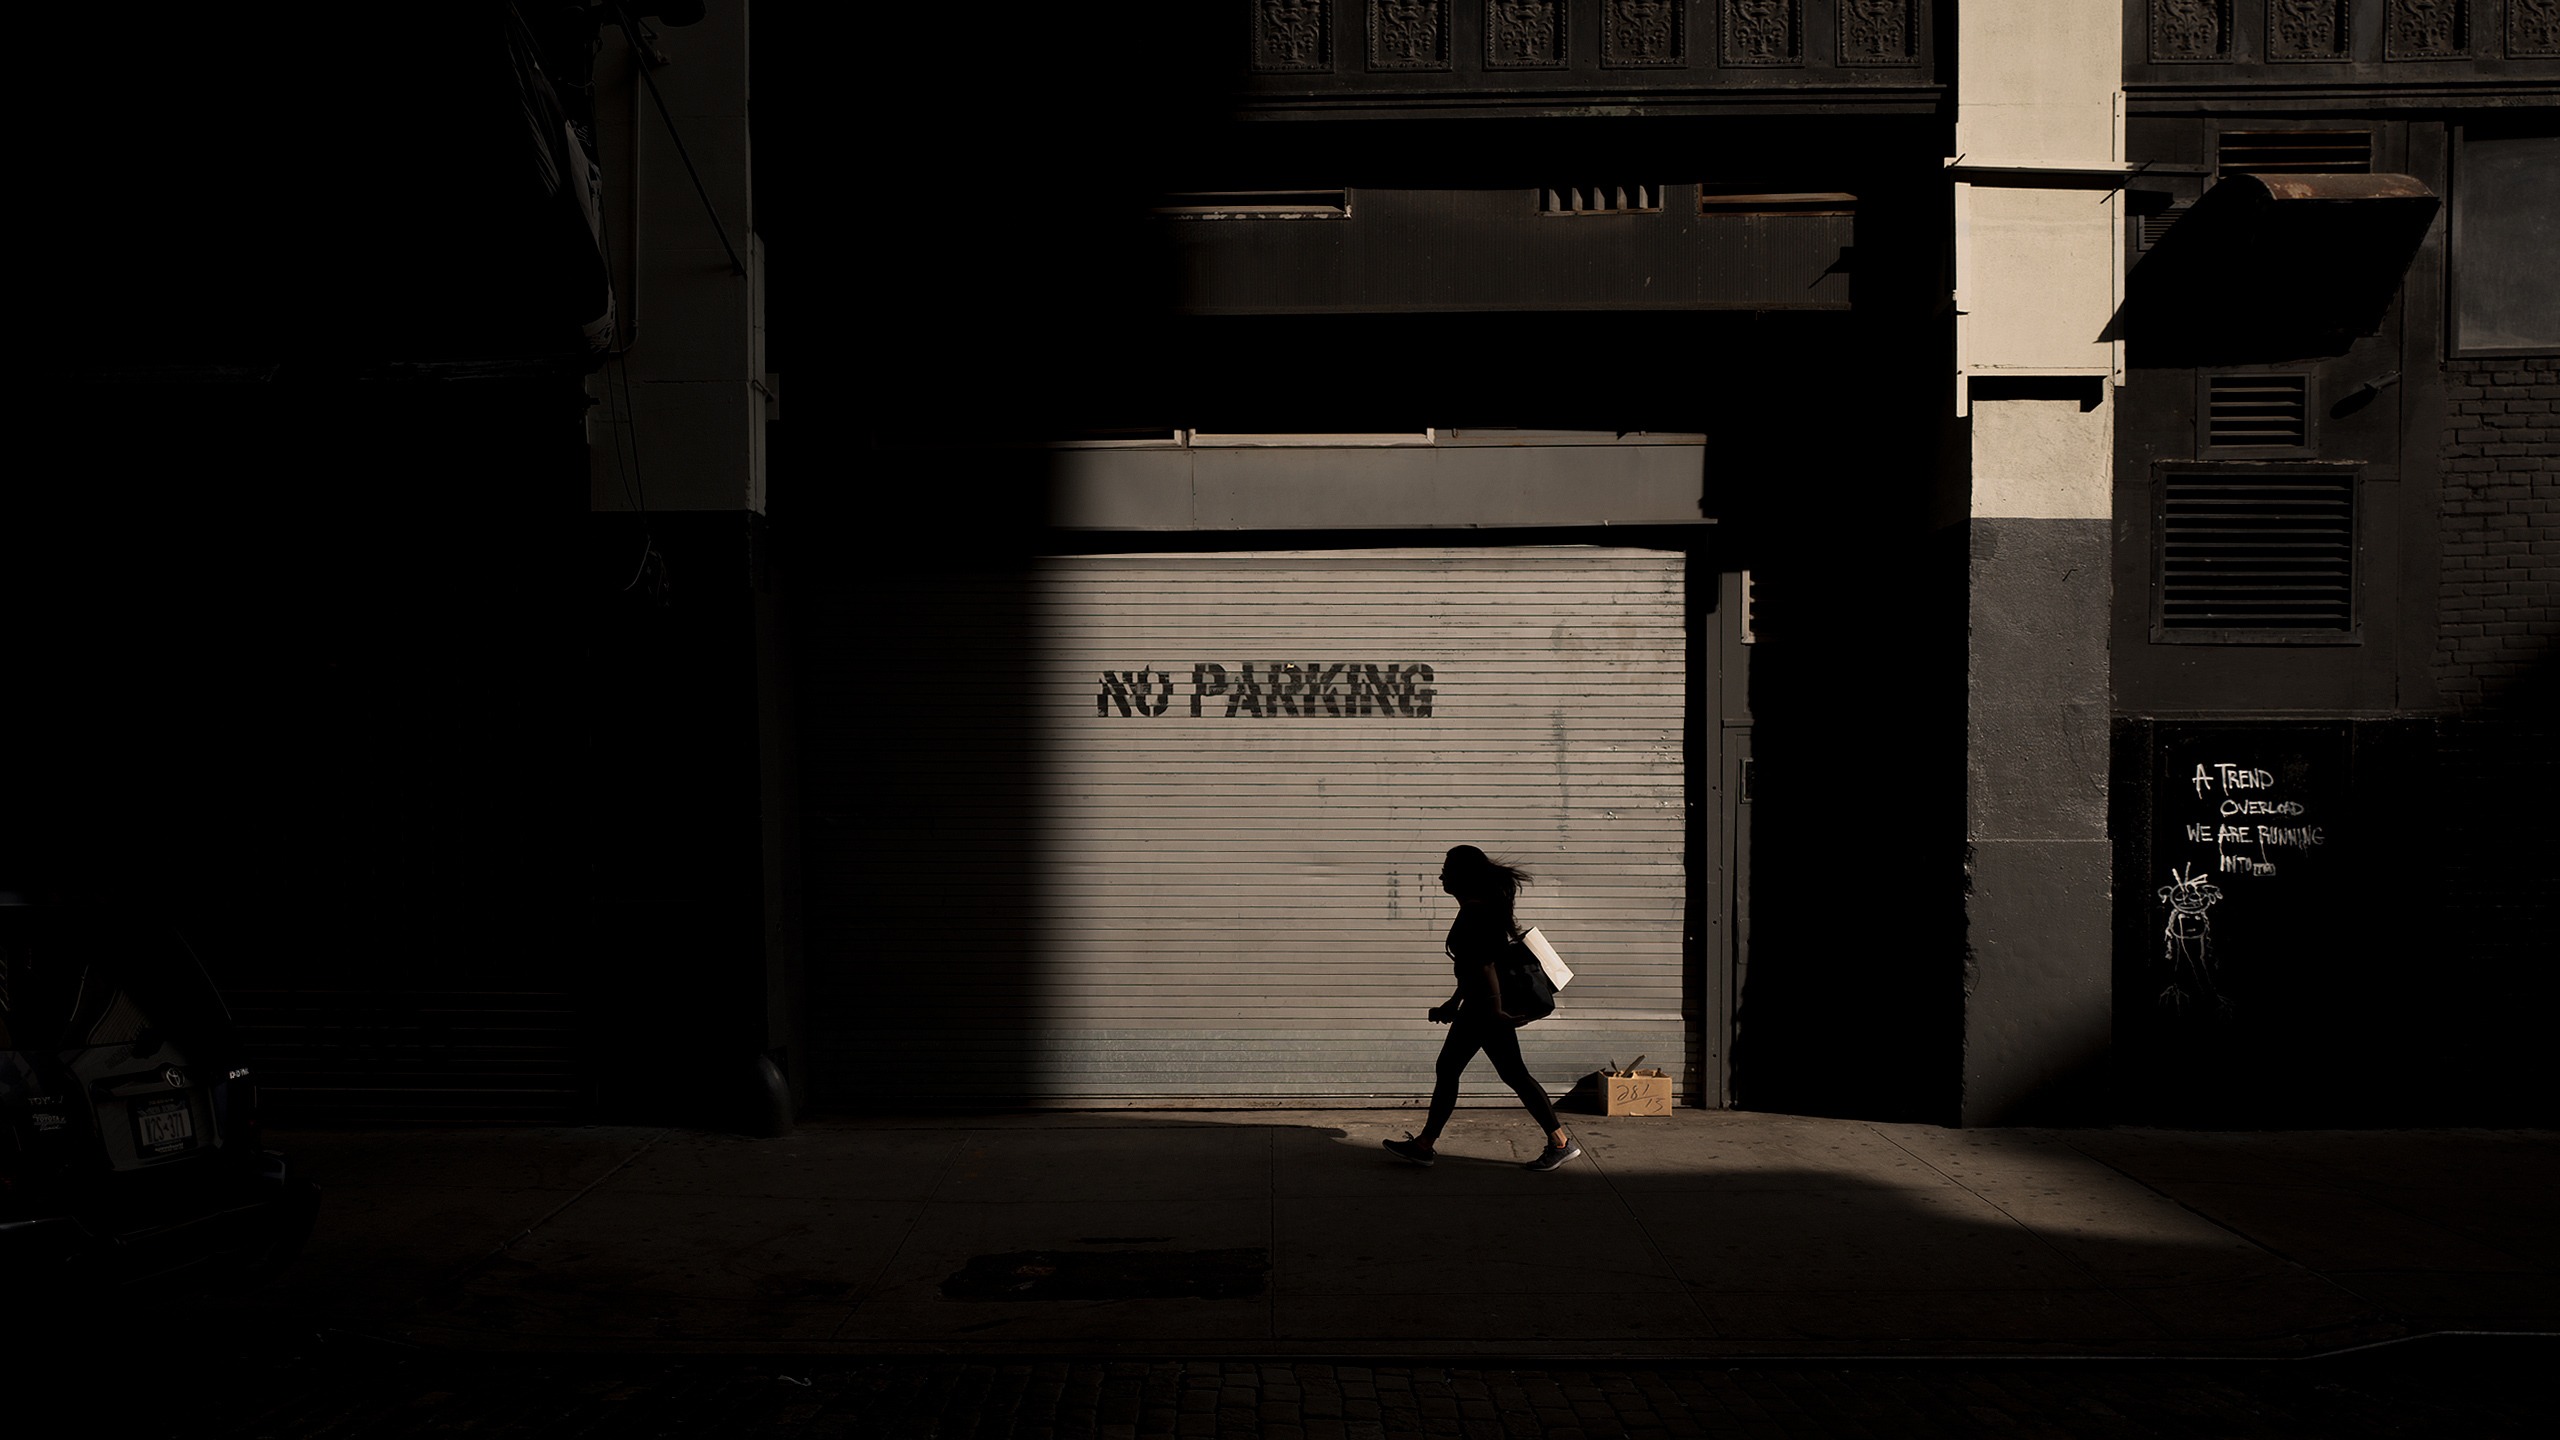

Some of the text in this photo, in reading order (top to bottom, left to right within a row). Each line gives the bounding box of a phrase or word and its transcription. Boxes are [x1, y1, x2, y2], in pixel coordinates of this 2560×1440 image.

[1097, 663, 1437, 718] NO PARKING
[2192, 763, 2275, 798] A TREND
[2220, 799, 2305, 818] OVERLOAD
[2186, 822, 2326, 848] WE ARE RUNNING
[2220, 854, 2252, 873] INTO
